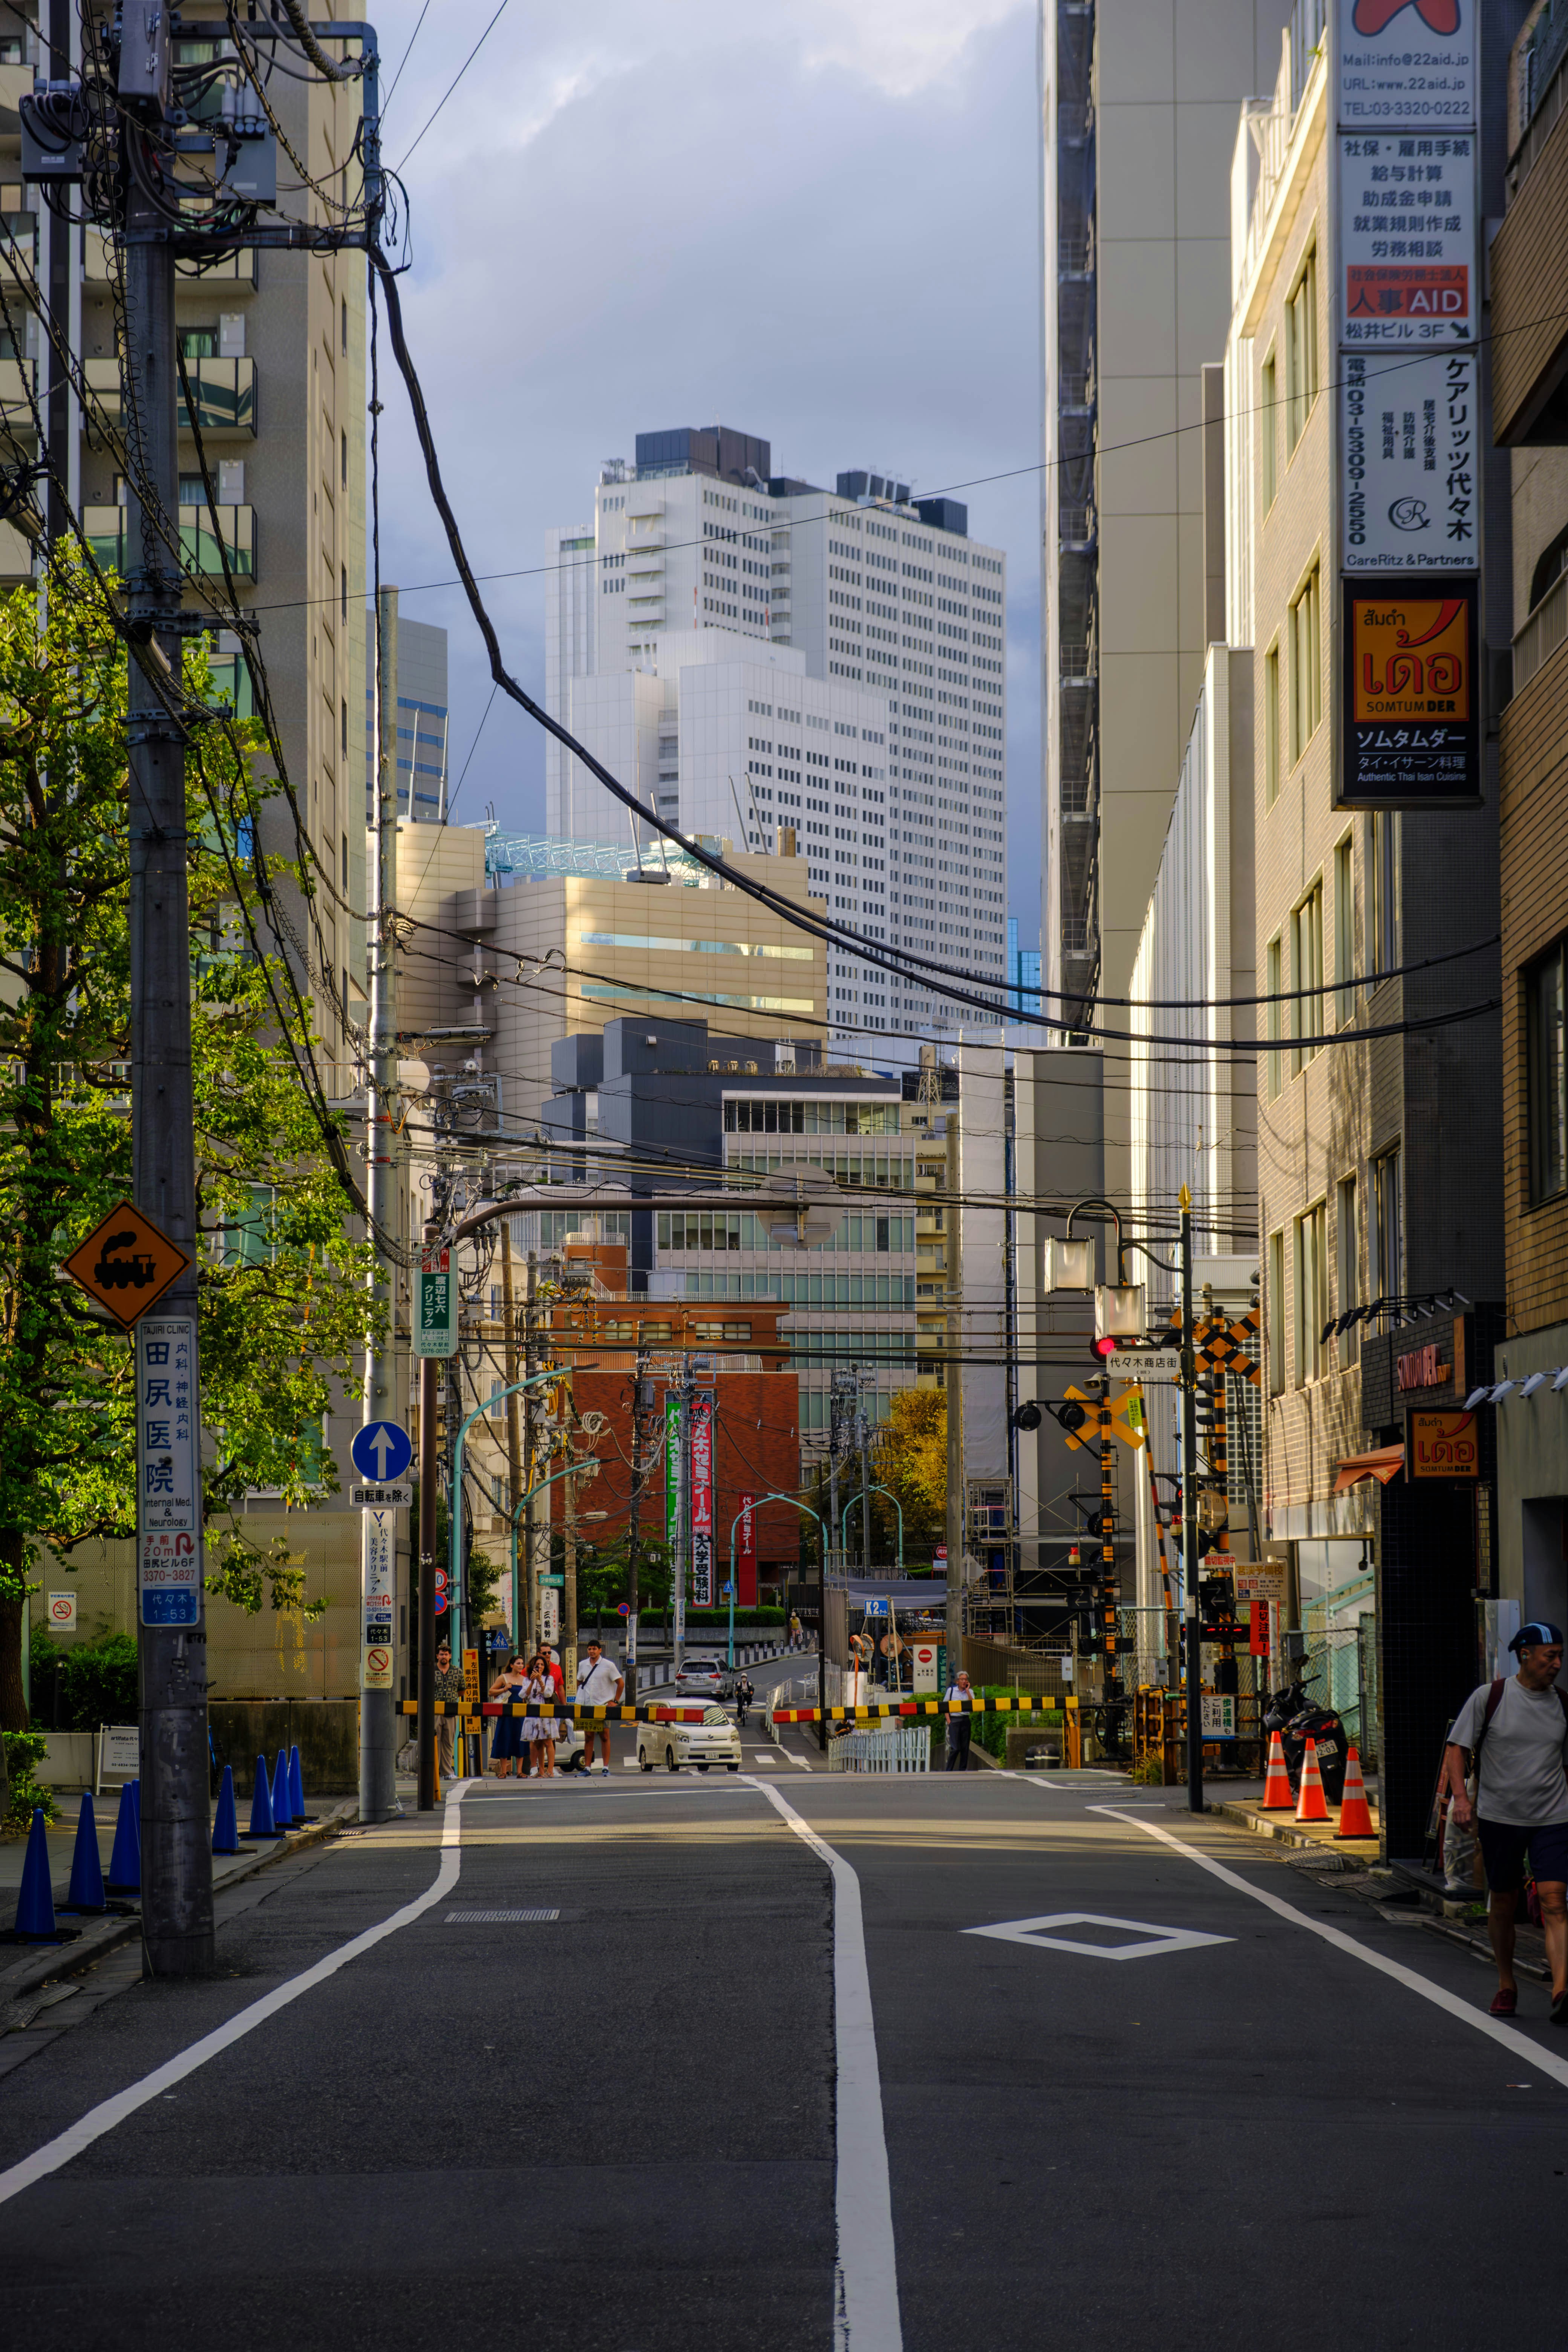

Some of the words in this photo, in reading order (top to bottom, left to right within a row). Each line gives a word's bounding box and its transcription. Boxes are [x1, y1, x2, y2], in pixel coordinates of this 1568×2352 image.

[1343, 52, 1469, 66] Mail:info@22aid.jp
[1344, 77, 1465, 90] URL:www.22aid.jp
[1344, 101, 1470, 115] TEL:03-3320-0222
[1344, 140, 1470, 156] 社保・雇用手続
[1371, 166, 1443, 182] 給与計算
[1362, 191, 1452, 207] 助成金申請
[1353, 216, 1461, 232] 就業規則作成
[1371, 241, 1443, 257] 労務相談
[1351, 268, 1464, 282] 社会保険労務士法人
[1409, 289, 1462, 312] AID
[1382, 412, 1394, 459] 福祉用具
[1403, 412, 1416, 459] 訪問介護
[1447, 358, 1473, 542] ケアリッツ代々木
[1347, 554, 1403, 566] CareRitz
[1406, 554, 1416, 565] &
[1418, 554, 1474, 565] Partners
[1367, 701, 1425, 713] SOMTUM
[1427, 700, 1456, 713] DER
[1357, 729, 1466, 748] ソムタムダー
[1358, 756, 1466, 769] タイ・イサーン料理
[1357, 772, 1396, 782] Authentic
[1399, 772, 1415, 781] Thai
[1417, 772, 1434, 781] Isan
[1436, 772, 1466, 781] Cuisine
[435, 1276, 446, 1314] 渡辺七六
[424, 1285, 434, 1328] クリニック
[143, 1325, 165, 1335] TAJIRI
[167, 1325, 189, 1334] CLINIC
[1110, 1357, 1177, 1368] 代々木商店街
[175, 1342, 189, 1441] 内科・神経内科
[145, 1342, 174, 1493] 田尻医院
[145, 1498, 173, 1507] Internal
[175, 1498, 191, 1507] Med.
[355, 1489, 409, 1503] 自転車を除く
[164, 1508, 172, 1516] &
[149, 1518, 187, 1527] Neurology
[146, 1535, 169, 1545] 手前
[380, 1529, 388, 1572] 代々木駅前
[370, 1538, 378, 1594] 美容クリニック
[144, 1570, 195, 1581] 3370-3827
[153, 1594, 187, 1604] 代々木
[154, 1609, 186, 1619] 1-53
